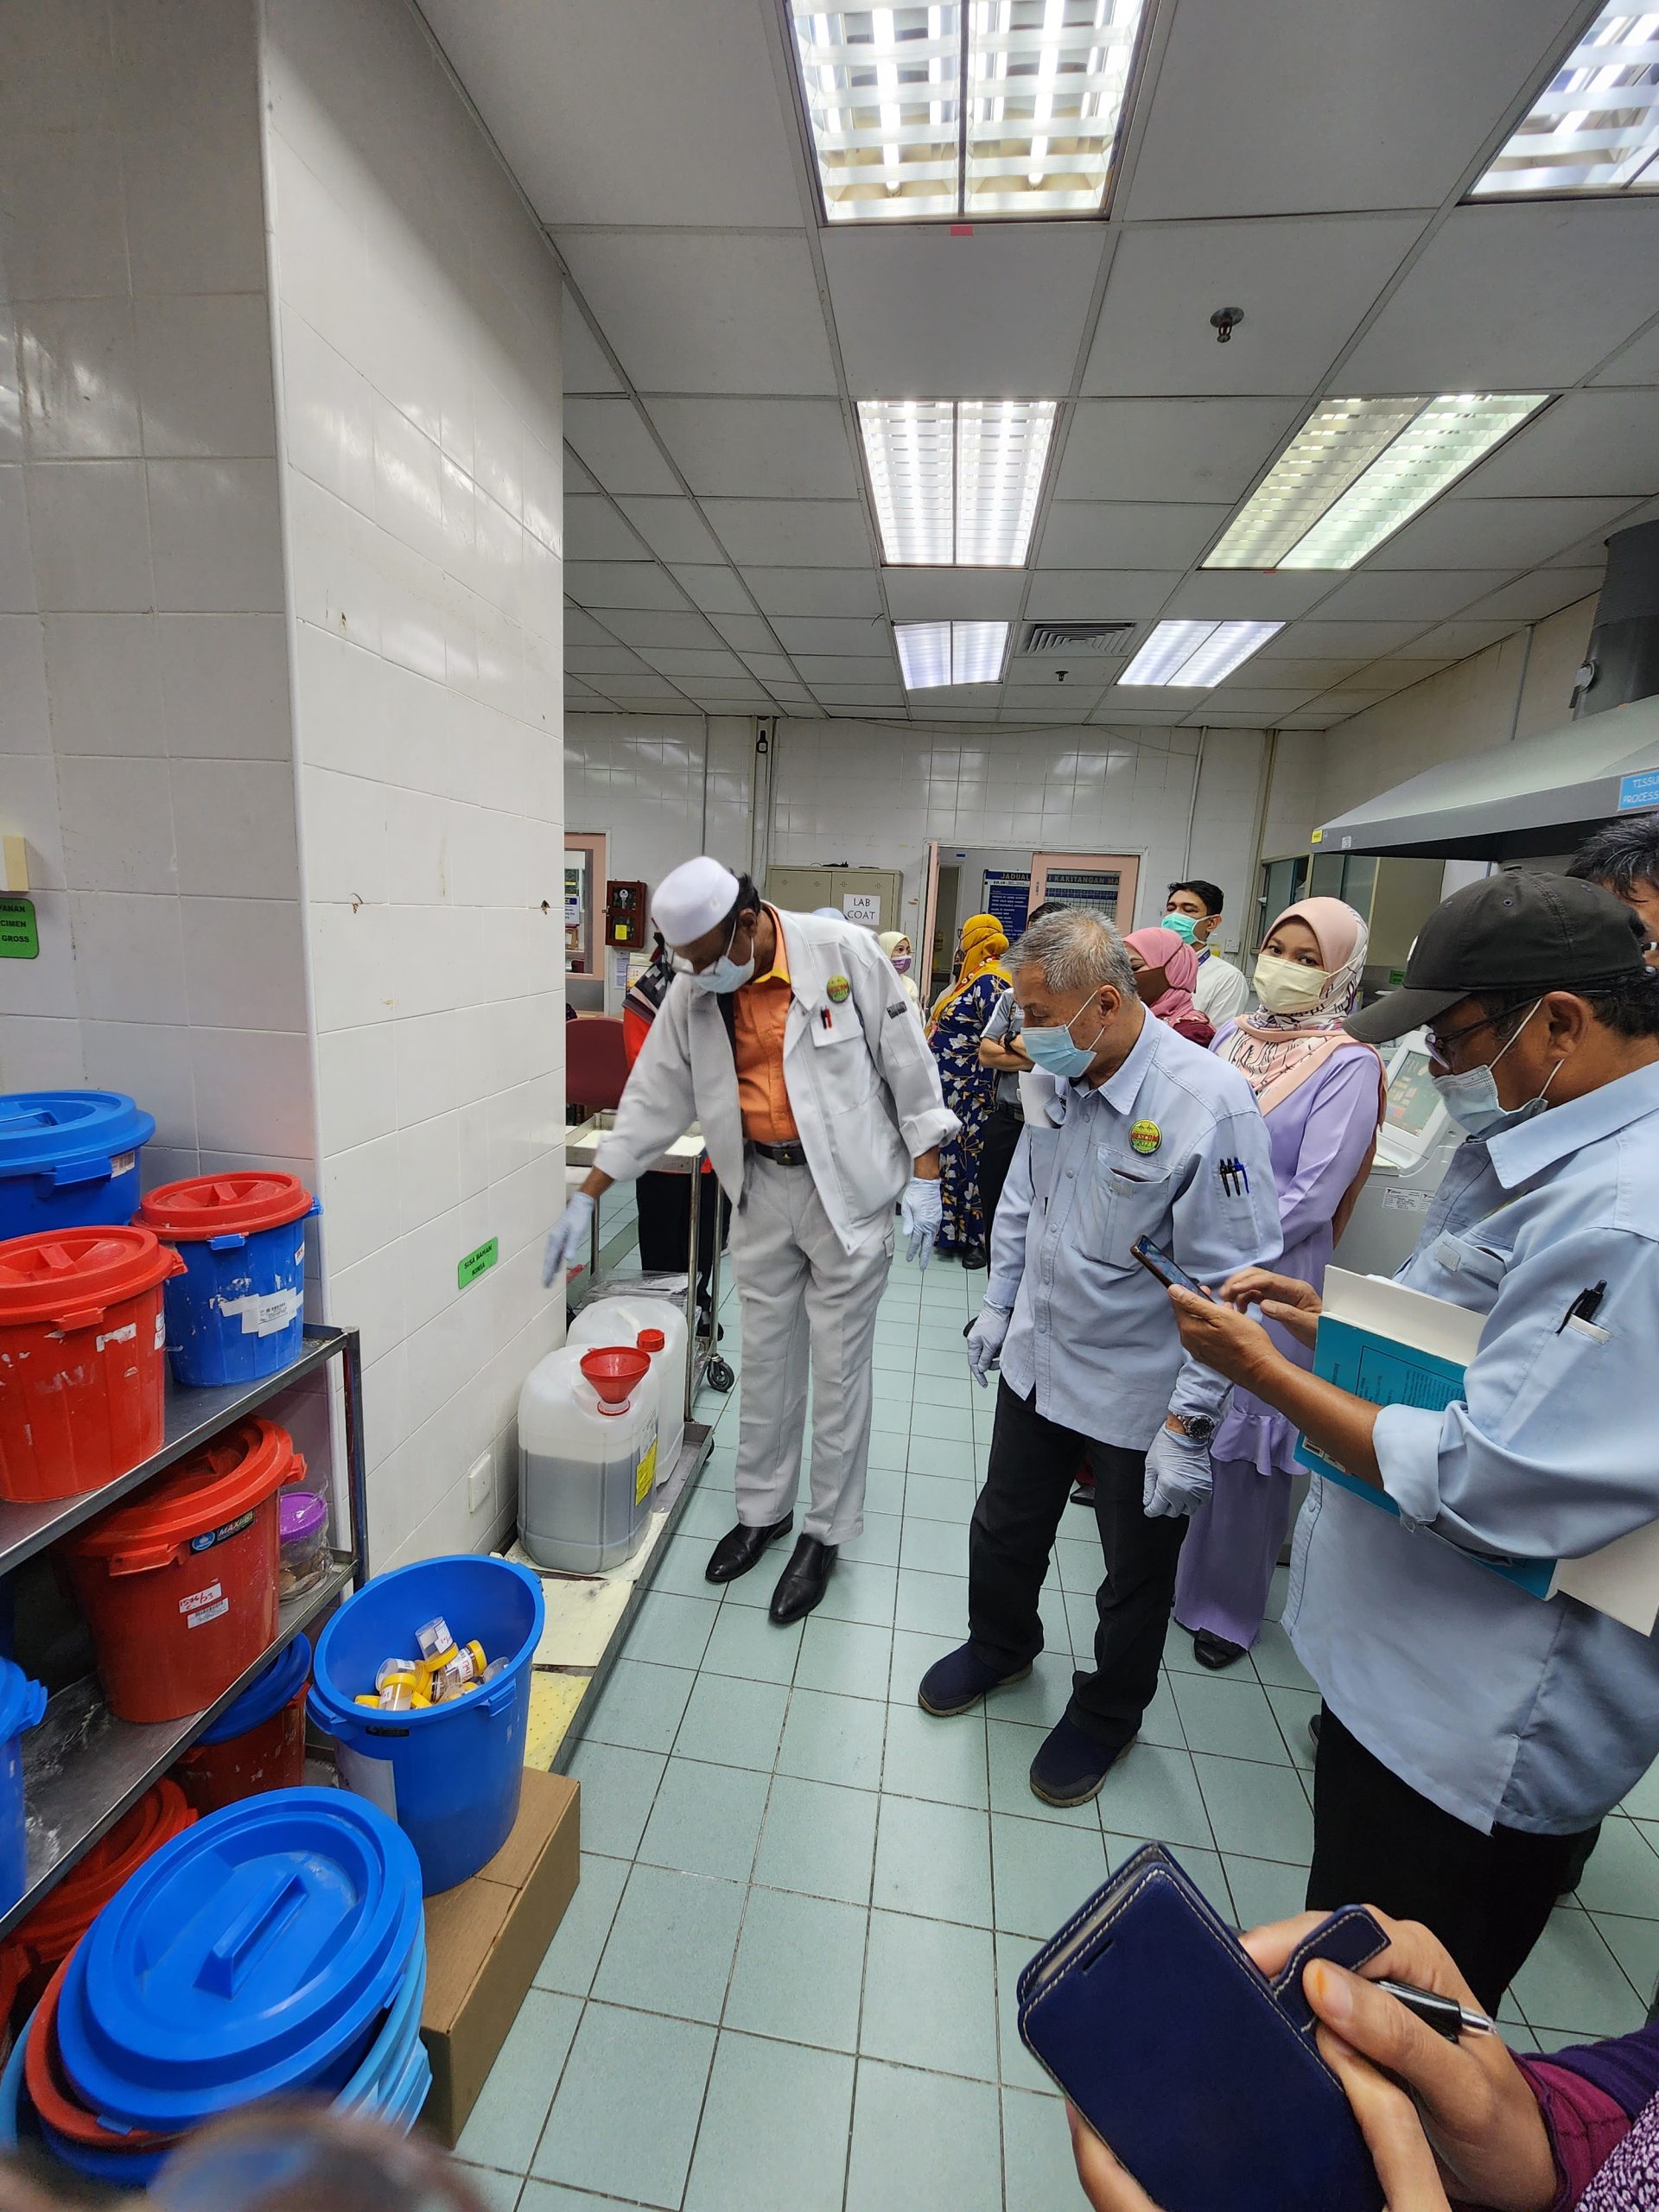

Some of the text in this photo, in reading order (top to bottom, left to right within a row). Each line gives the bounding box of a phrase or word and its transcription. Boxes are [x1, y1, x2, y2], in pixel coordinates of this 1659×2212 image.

[1054, 875, 1104, 884] KAKITANGAN
[854, 898, 871, 906] LAB
[848, 910, 876, 919] COAT
